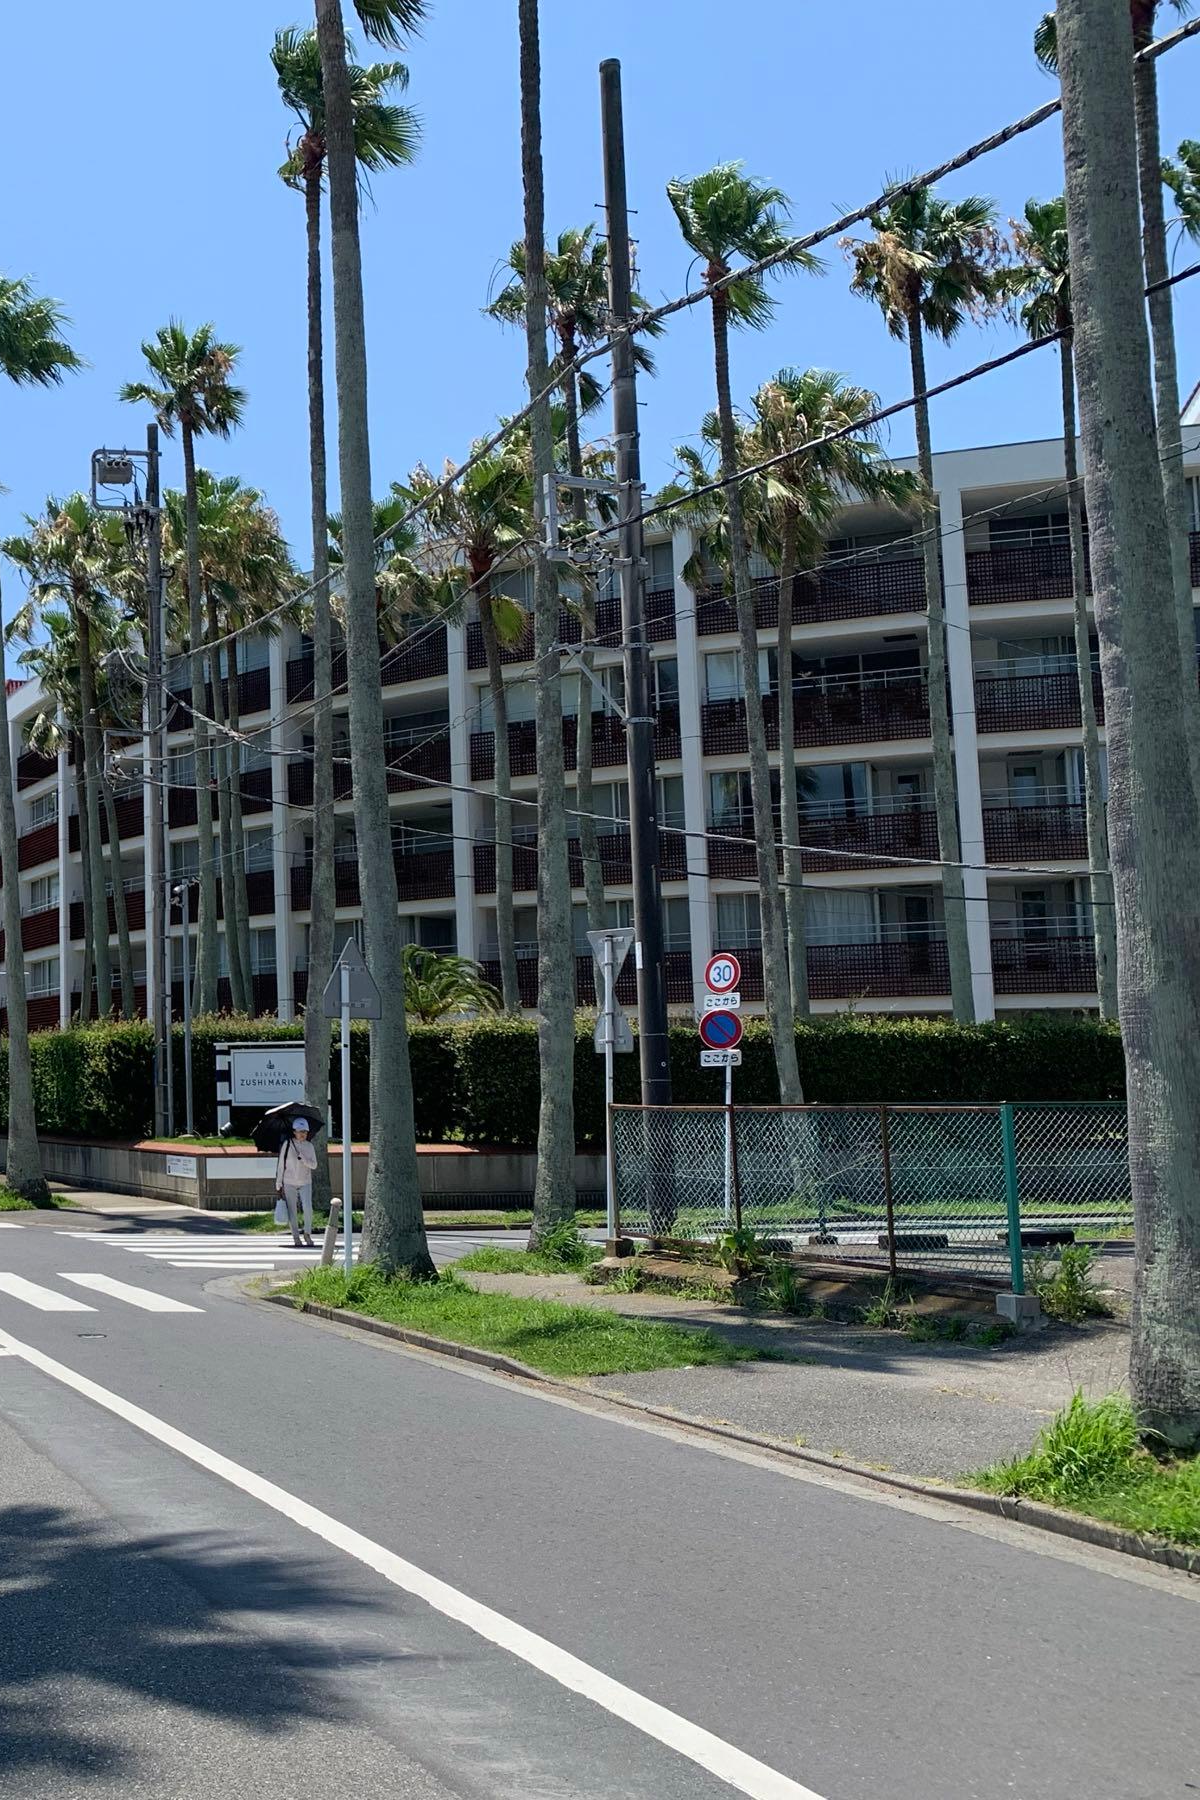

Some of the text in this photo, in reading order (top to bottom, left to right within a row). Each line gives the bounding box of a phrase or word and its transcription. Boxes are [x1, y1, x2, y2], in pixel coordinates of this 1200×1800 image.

[712, 965, 732, 983] 30
[706, 996, 738, 1007] ここから
[703, 1053, 740, 1063] ここから
